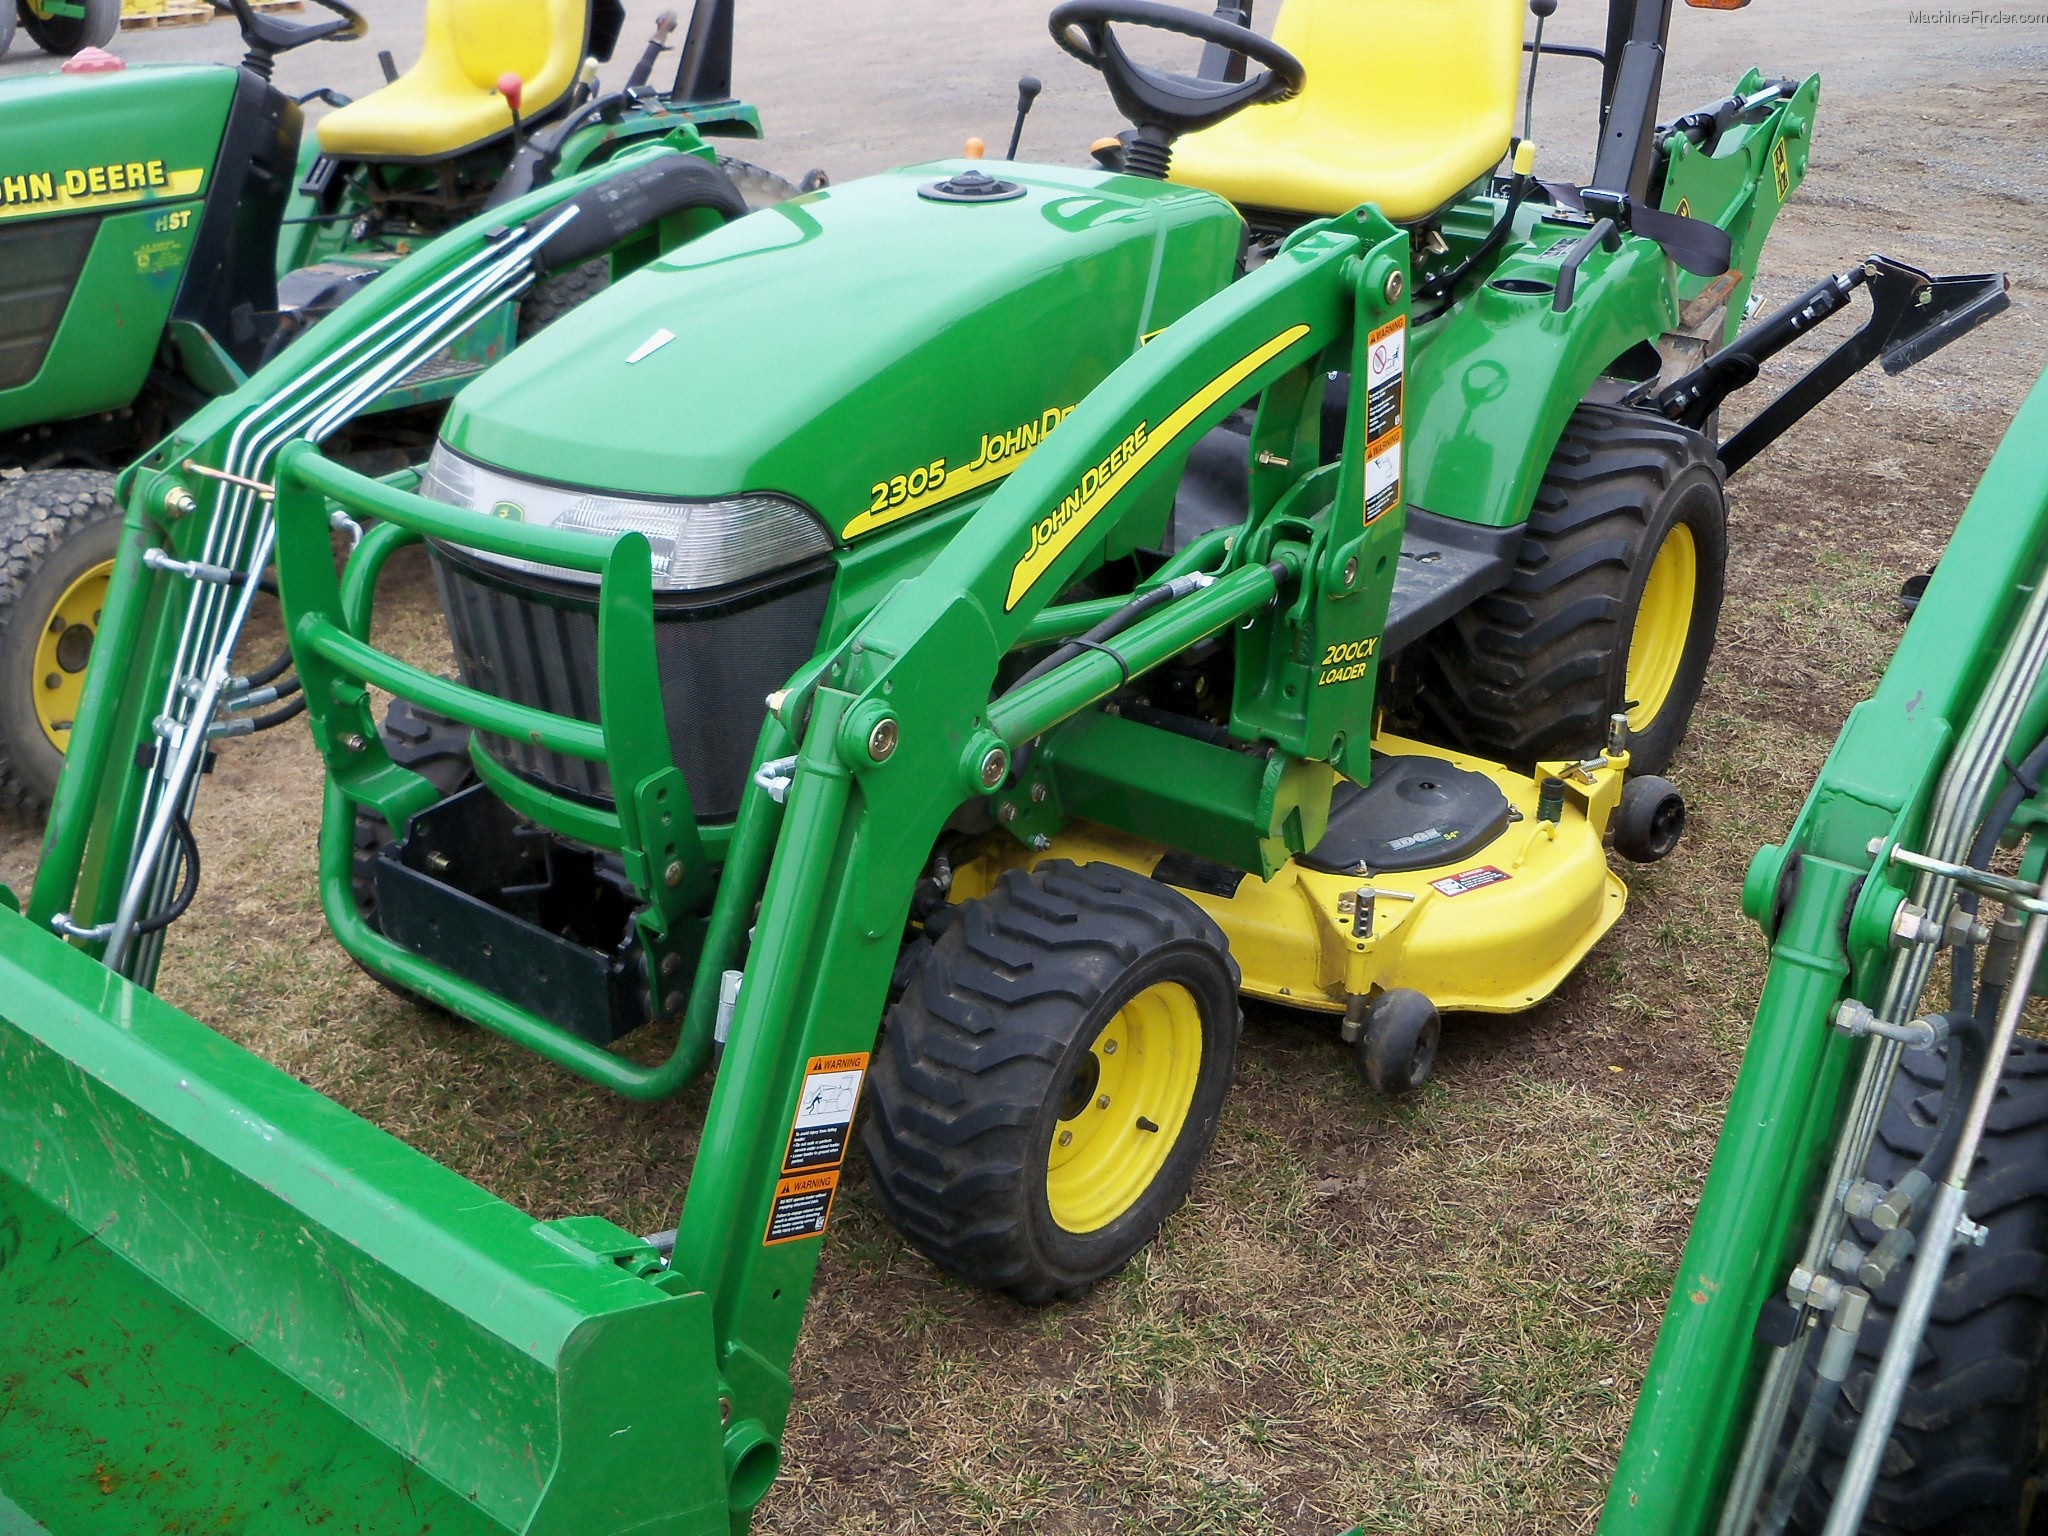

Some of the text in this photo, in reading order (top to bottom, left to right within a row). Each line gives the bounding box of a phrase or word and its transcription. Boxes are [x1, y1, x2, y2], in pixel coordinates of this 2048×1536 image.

[64, 159, 165, 197] DEERE
[155, 209, 192, 233] HST
[1376, 318, 1403, 342] WARNING
[969, 418, 1039, 472] JOHN
[1373, 431, 1400, 455] WARNING
[869, 457, 947, 516] 2305
[1024, 487, 1081, 561] JOHN
[1079, 420, 1149, 506] DEERE
[1321, 636, 1379, 666] 200CX
[1318, 662, 1367, 686] LOADER
[824, 1057, 861, 1069] WARNING
[794, 1176, 832, 1191] WARNING
